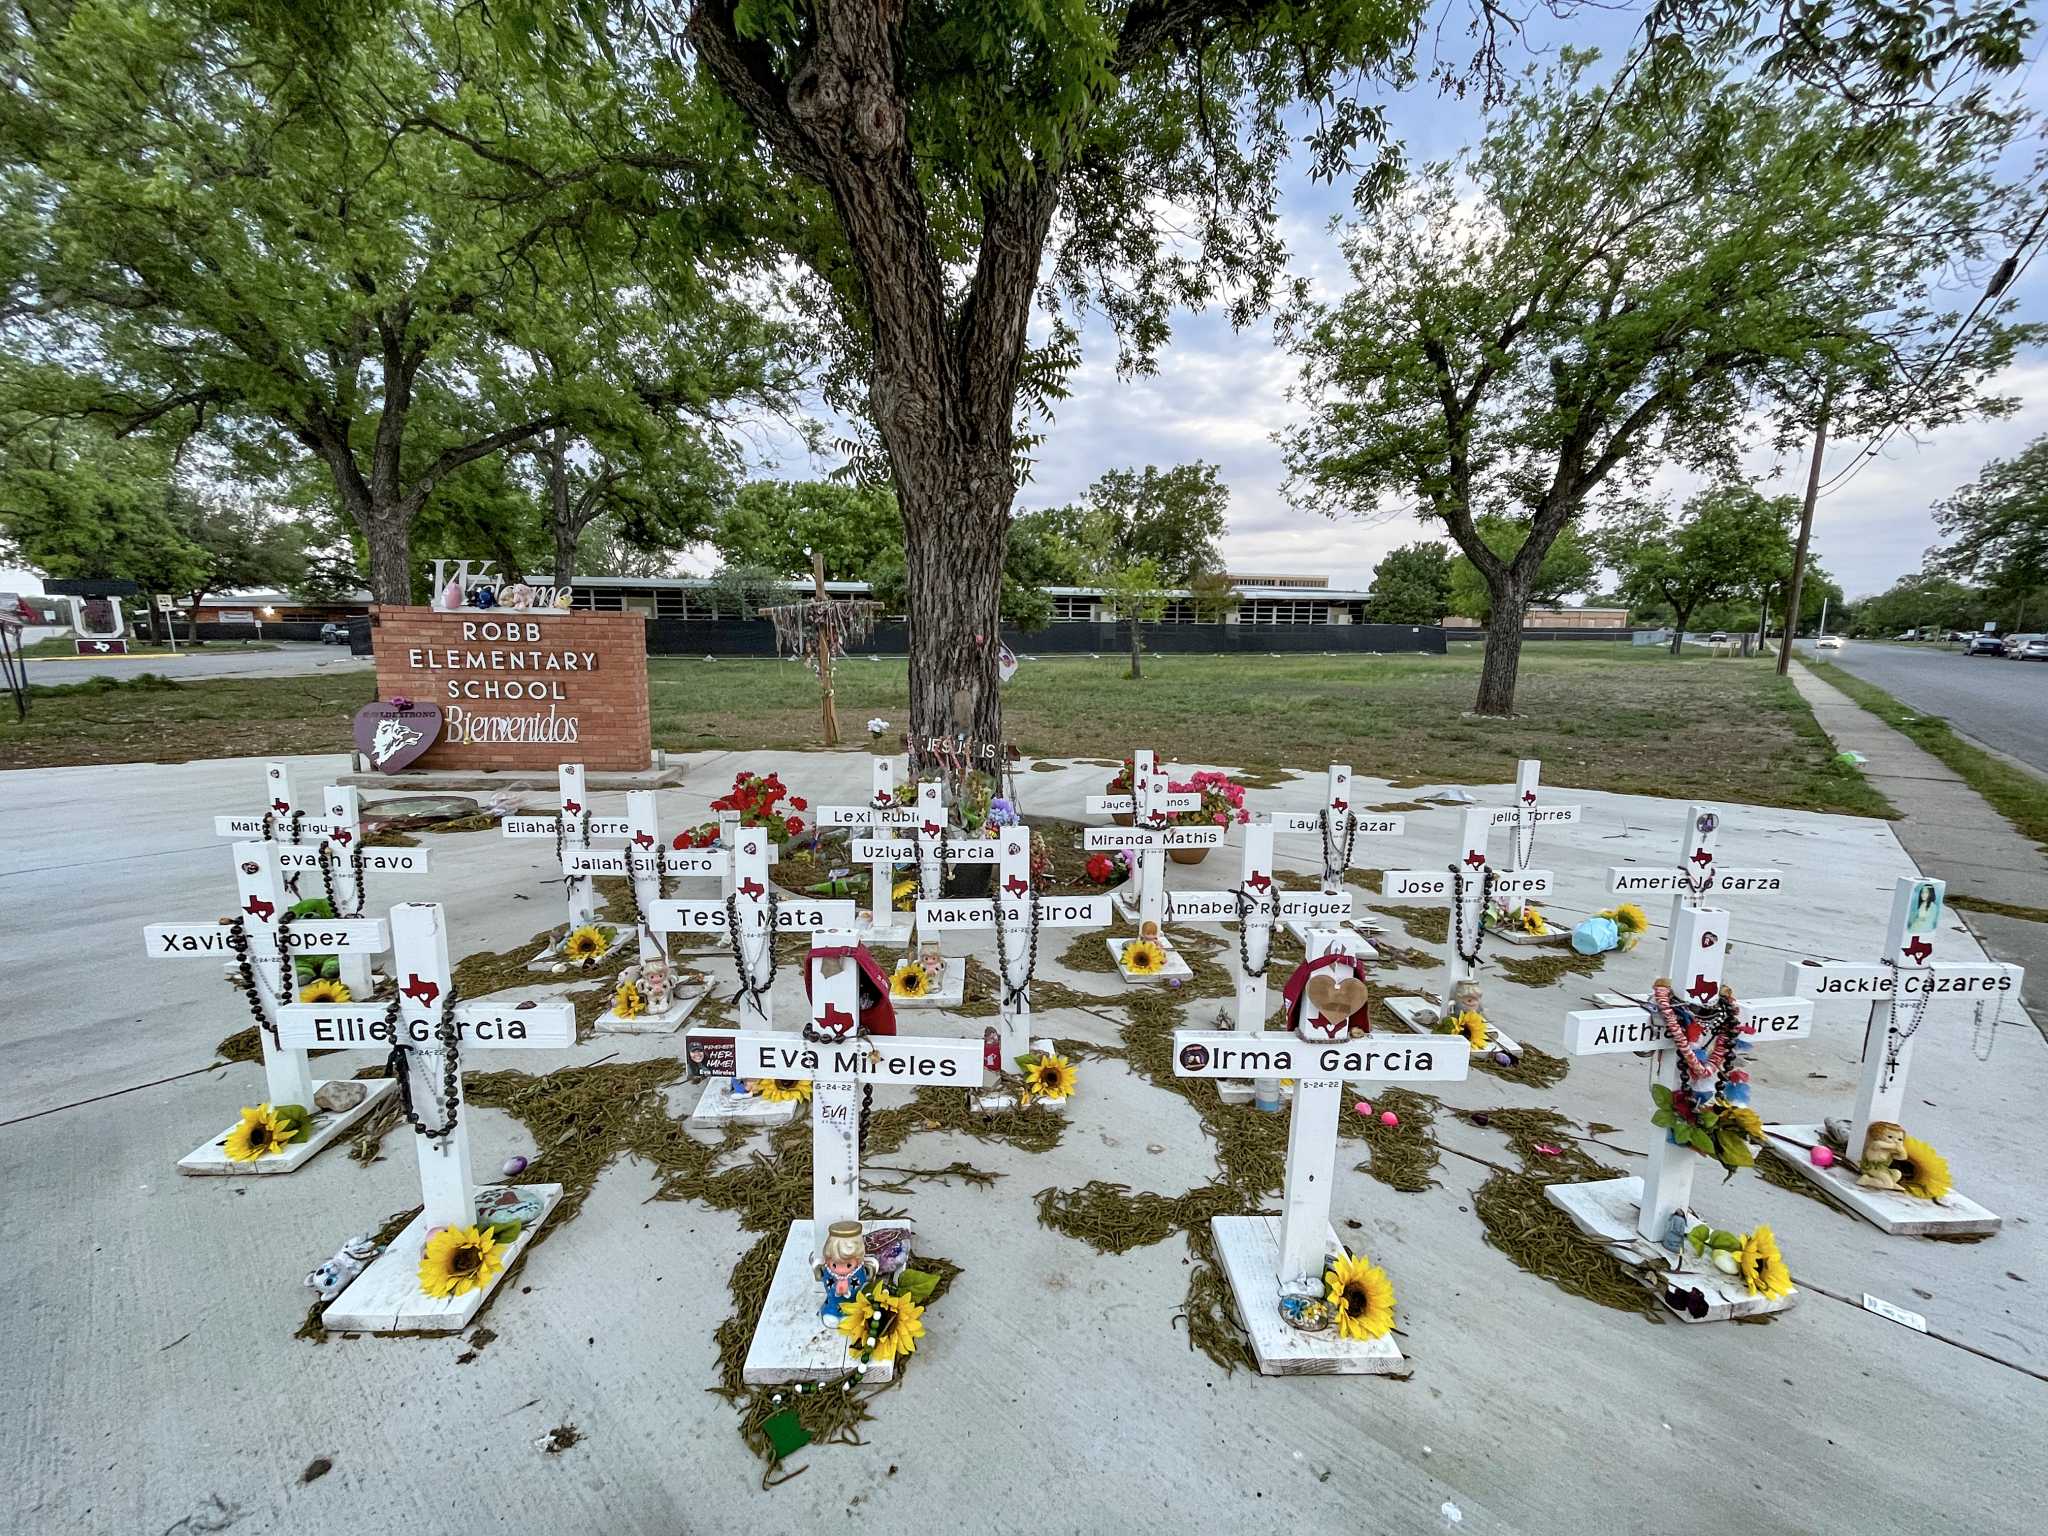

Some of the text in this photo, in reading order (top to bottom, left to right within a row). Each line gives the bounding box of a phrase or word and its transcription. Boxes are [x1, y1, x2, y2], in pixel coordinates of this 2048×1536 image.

[432, 559, 573, 608] Wlme
[463, 622, 541, 642] ROBB
[409, 649, 597, 671] ELEMENTARY
[447, 680, 566, 700] SCHOOL
[445, 704, 579, 743] Bienvenidos
[981, 743, 996, 758] IS
[834, 811, 871, 823] Lexi
[1528, 809, 1572, 821] Torres
[231, 821, 329, 836] Mait Rorigu
[580, 822, 629, 833] orre
[1335, 820, 1396, 832] Sazar
[1091, 832, 1217, 846] Miranda Mathis
[933, 846, 994, 859] Garcia
[280, 855, 341, 867] evah
[572, 857, 712, 872] Jailah Siluero
[1398, 879, 1444, 894] Jose
[1490, 878, 1546, 893] lores
[1615, 875, 1688, 889] Amerie
[1722, 876, 1780, 890] Garza
[1036, 904, 1092, 921] Elrod
[1164, 901, 1351, 917] Annabele Rdriguez
[758, 910, 823, 927] Mata
[273, 932, 350, 950] Lopez
[1816, 975, 2012, 993] Jackie Cazares
[315, 1018, 388, 1042] Ellie
[1751, 1014, 1800, 1033] irez
[759, 1046, 957, 1077] Eva Mireles
[1213, 1047, 1433, 1072] Irma Garcia
[1303, 1081, 1340, 1089] 5-24-22
[822, 1104, 847, 1121] EVA
